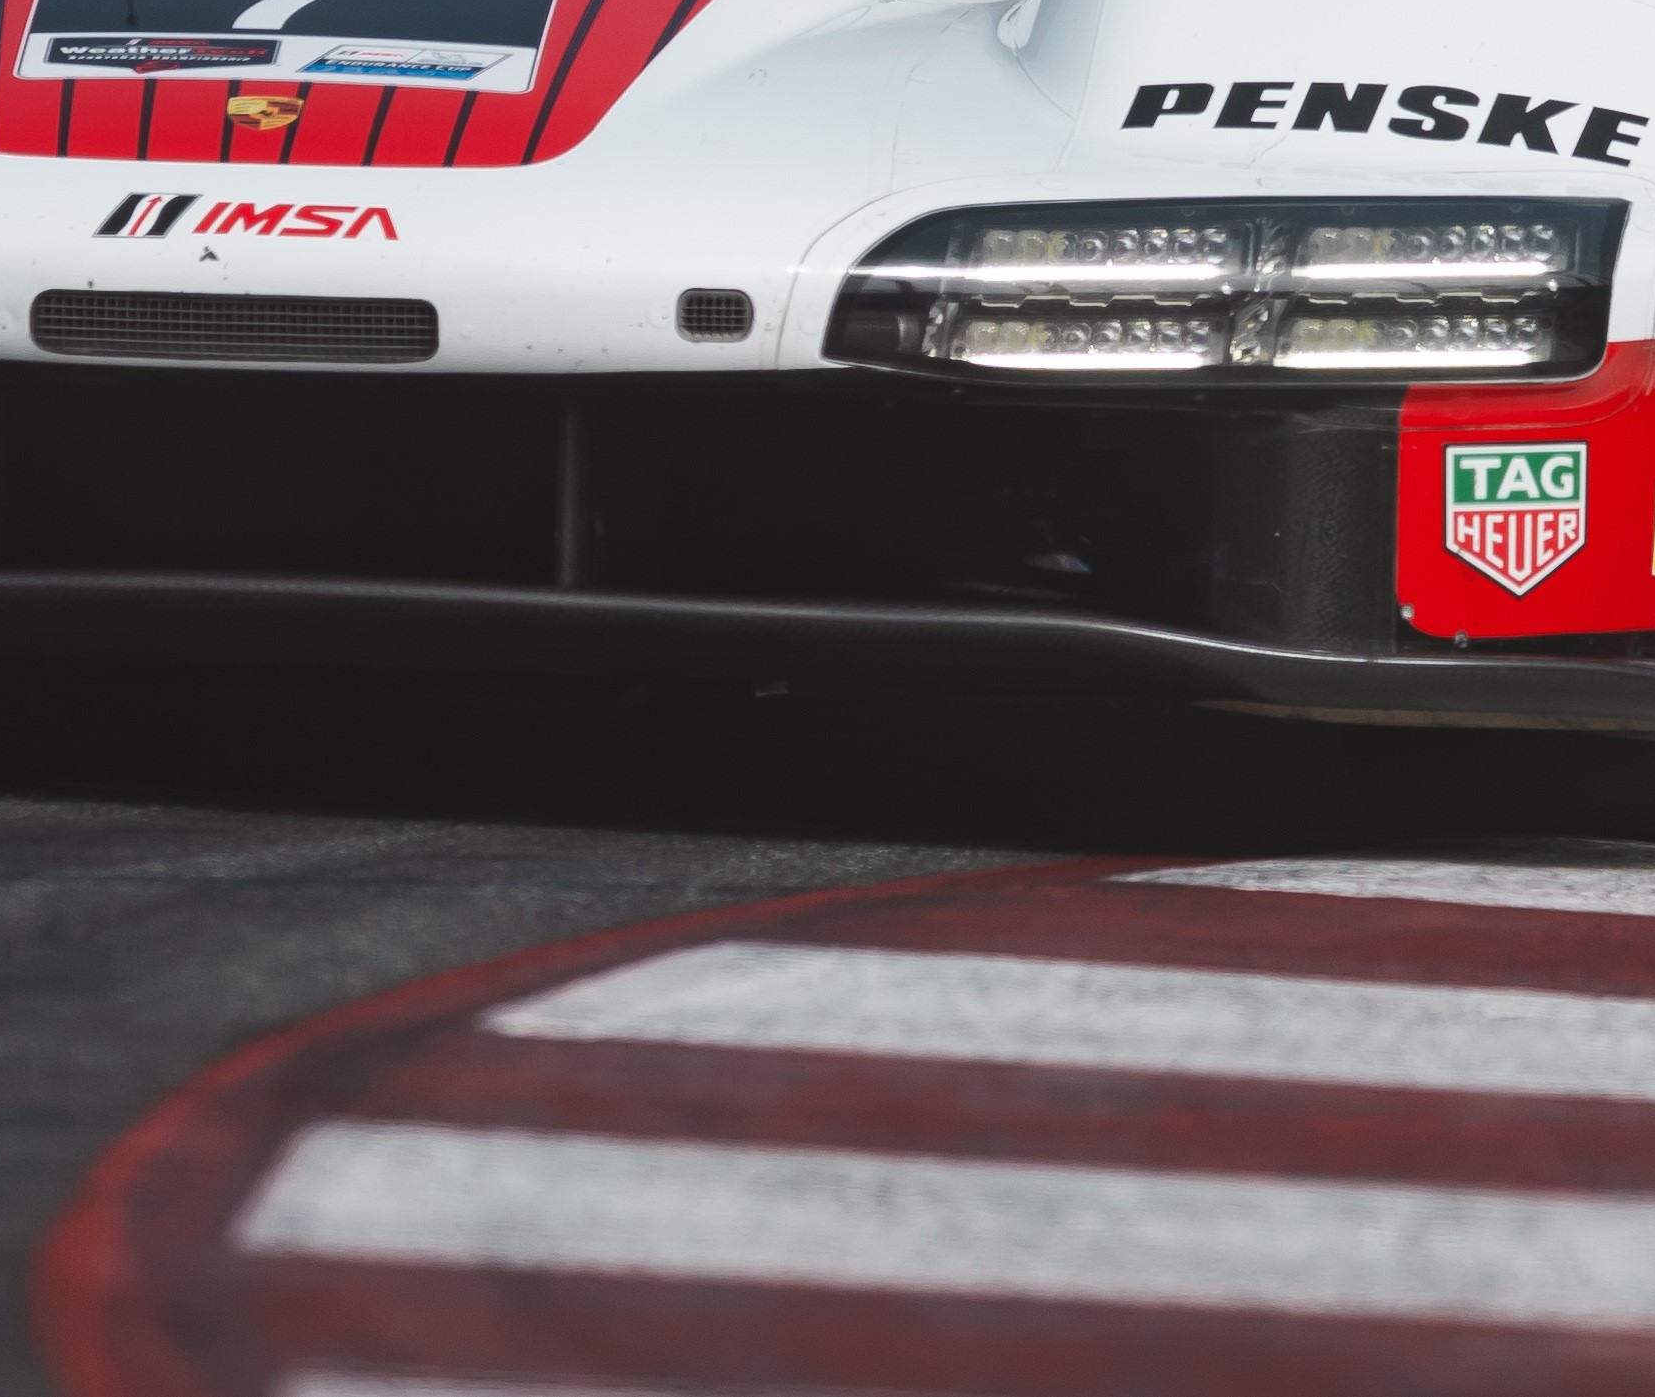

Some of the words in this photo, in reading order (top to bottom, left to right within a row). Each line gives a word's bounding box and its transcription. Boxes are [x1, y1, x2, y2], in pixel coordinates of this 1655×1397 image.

[1121, 81, 1650, 167] PENSKE
[192, 201, 399, 241] IMSA
[1459, 456, 1575, 501] TAG
[1456, 512, 1578, 582] HEUER
